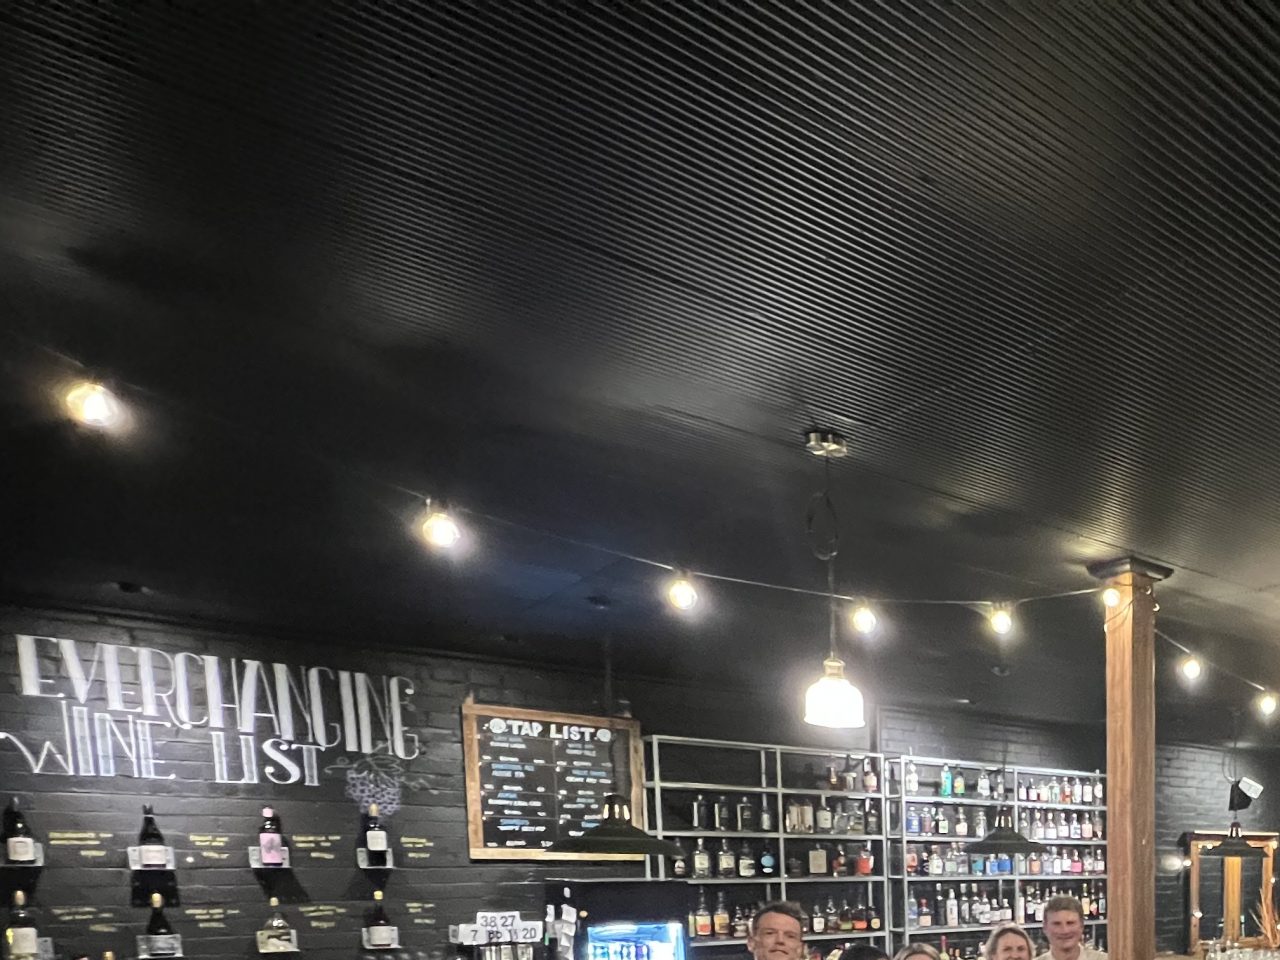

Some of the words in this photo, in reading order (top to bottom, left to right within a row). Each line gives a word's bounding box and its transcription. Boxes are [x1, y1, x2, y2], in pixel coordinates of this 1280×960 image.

[16, 634, 420, 760] EVERCHANGING
[506, 720, 543, 737] TAP
[550, 724, 596, 742] LIST
[0, 701, 176, 780] WINE
[210, 731, 326, 786] LIST
[480, 915, 497, 928] 38
[500, 915, 516, 927] 27
[471, 930, 478, 941] 7
[522, 928, 537, 940] 20
